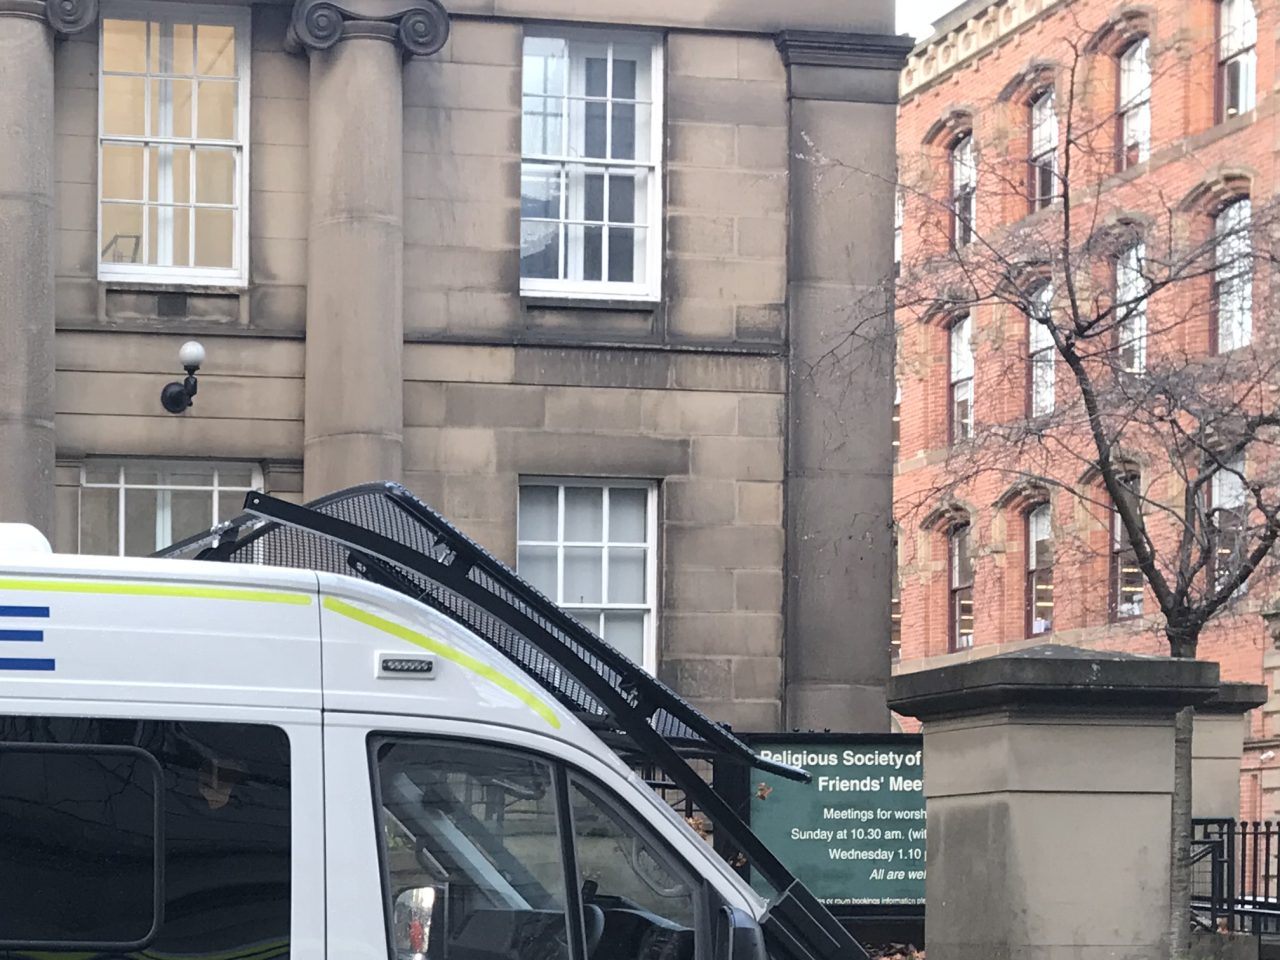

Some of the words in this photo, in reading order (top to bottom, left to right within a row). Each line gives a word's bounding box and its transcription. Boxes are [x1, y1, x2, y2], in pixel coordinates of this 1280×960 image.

[760, 750, 838, 768] Religious
[843, 750, 903, 769] Society
[905, 751, 921, 766] of
[818, 776, 884, 791] Friends'
[889, 776, 924, 791] Mee
[823, 808, 874, 822] Meetings
[877, 808, 892, 820] for
[895, 808, 927, 820] worsh
[791, 828, 833, 842] Sunday
[837, 829, 847, 840] at
[851, 829, 881, 840] 10.30
[884, 830, 905, 840] am.
[829, 849, 894, 862] Wednesday
[898, 849, 922, 860] 1.10
[869, 869, 884, 880] All
[887, 871, 905, 880] are
[852, 897, 880, 905] bookings
[881, 896, 916, 905] information
